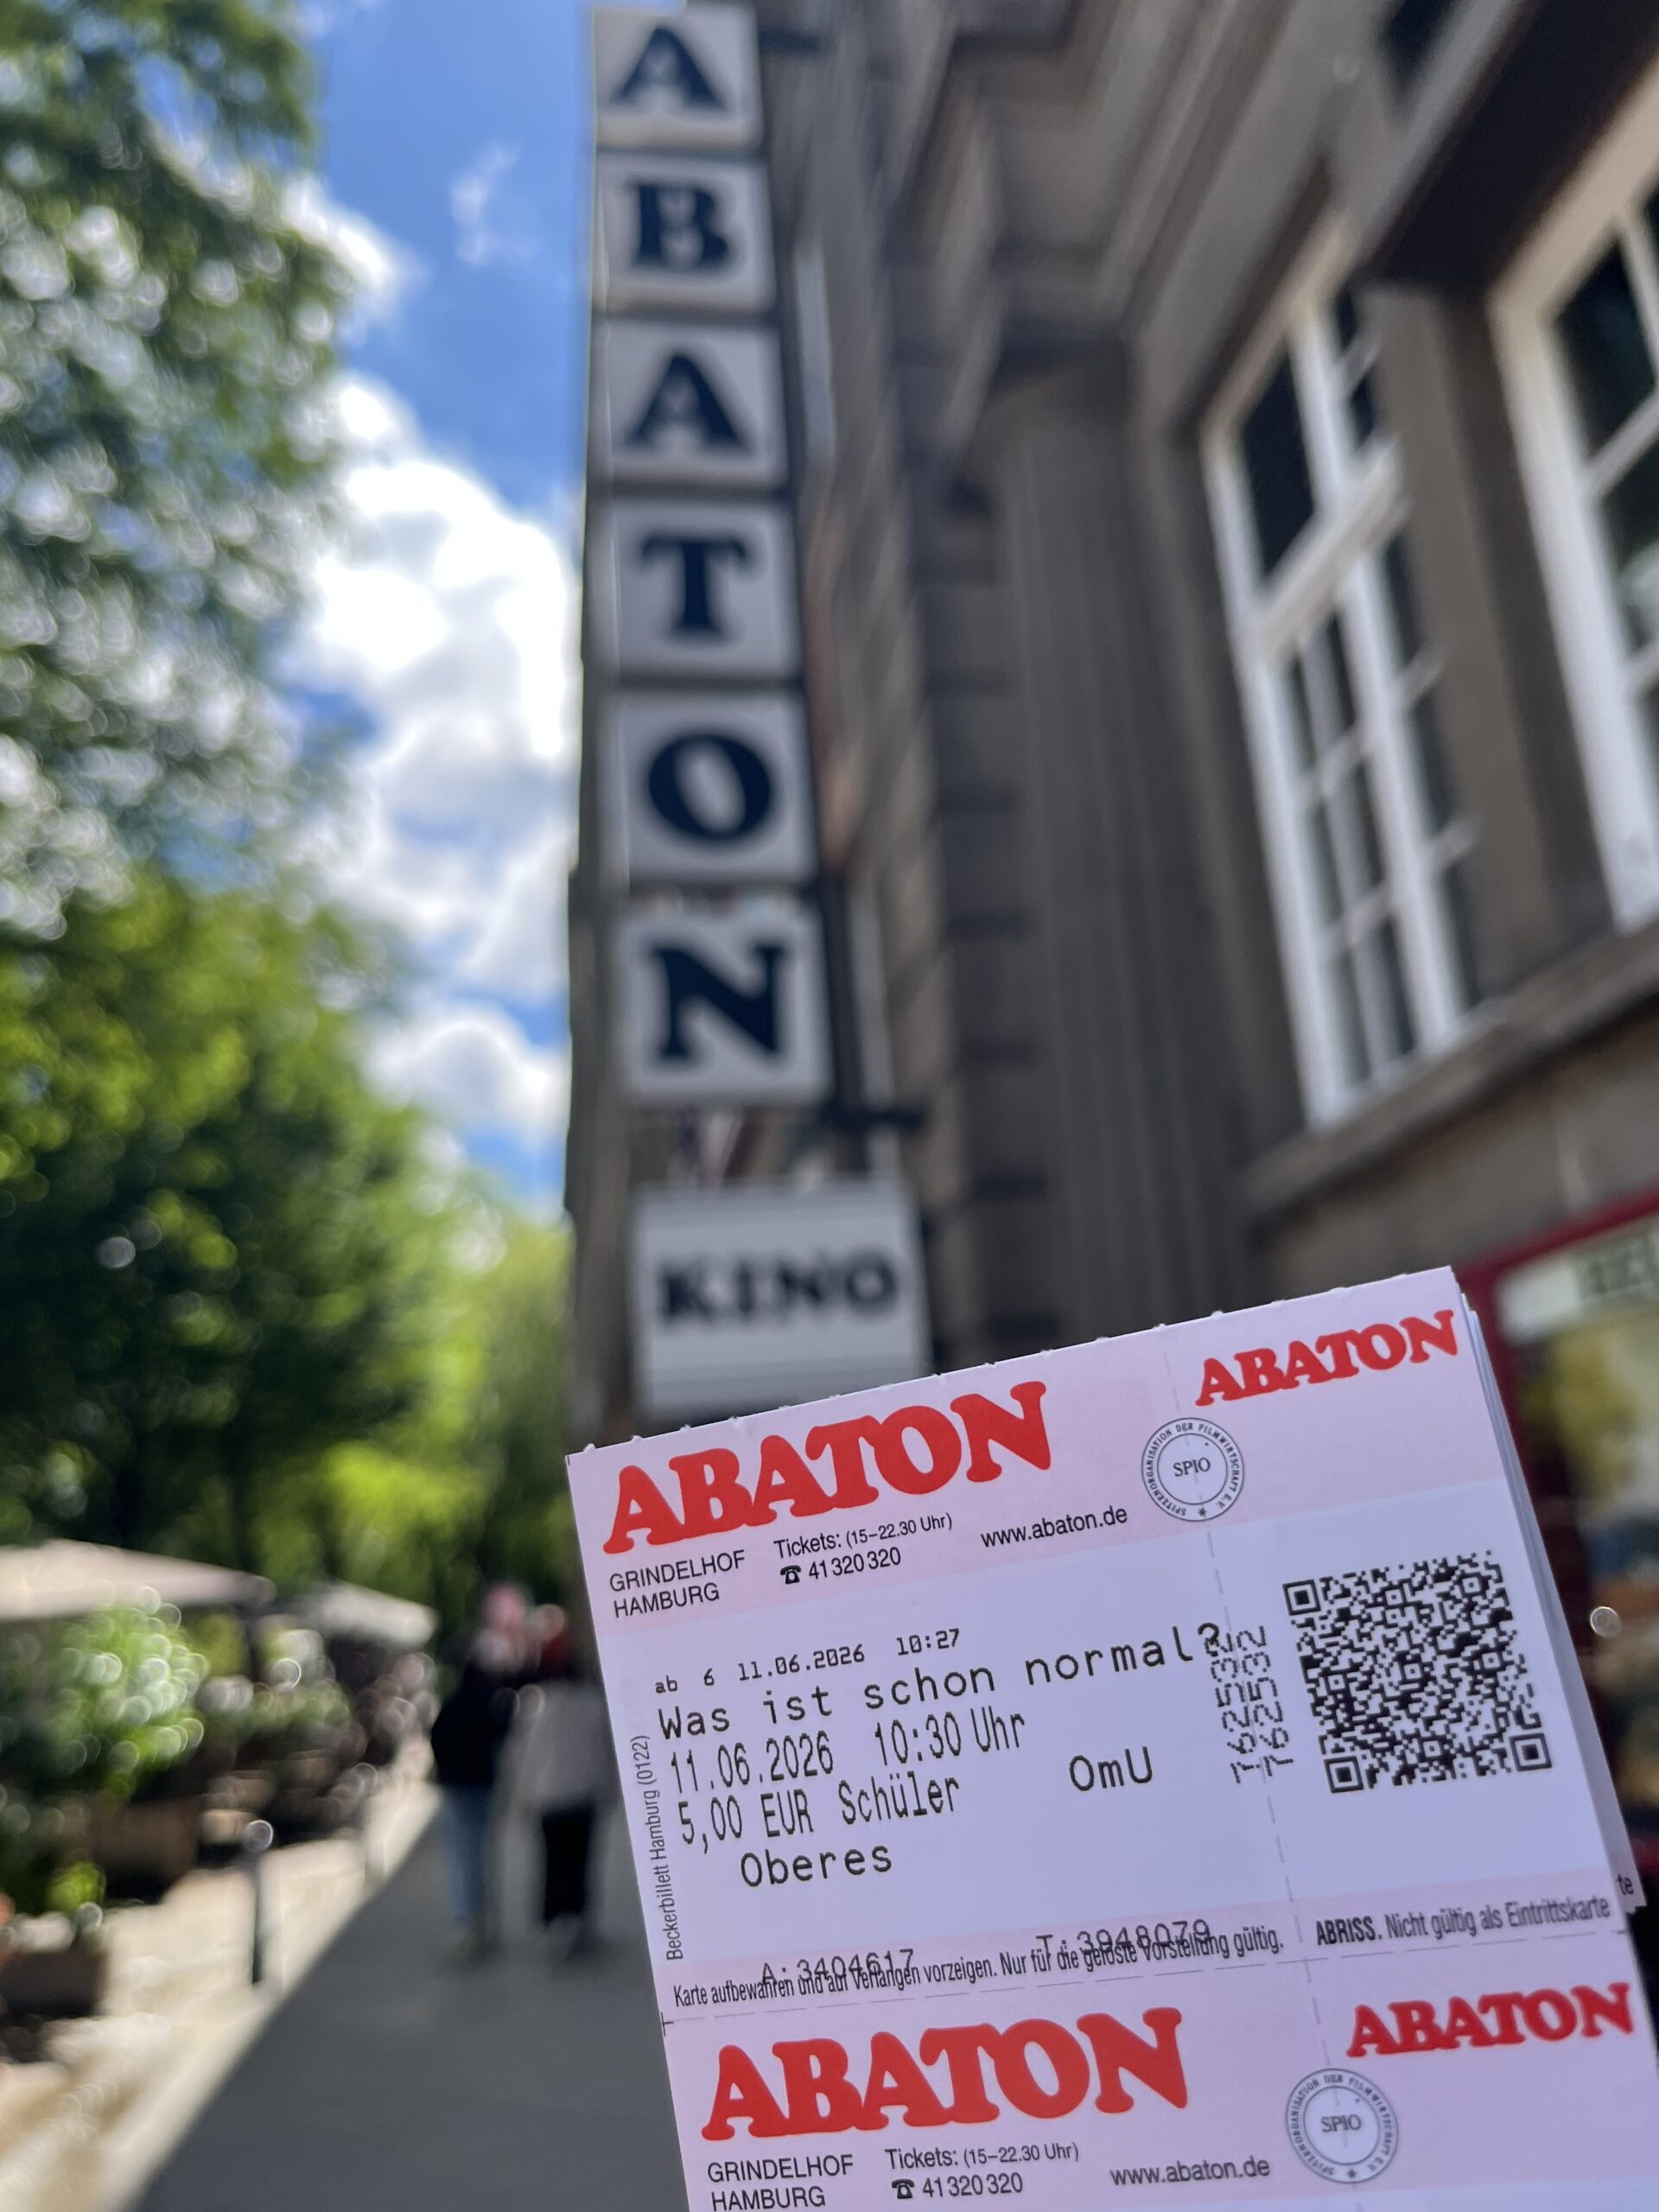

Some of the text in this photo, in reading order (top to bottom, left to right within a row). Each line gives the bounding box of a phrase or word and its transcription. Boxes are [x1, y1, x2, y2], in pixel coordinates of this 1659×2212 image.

[607, 24, 788, 1069] ABATON
[659, 1251, 900, 1325] KINO
[1196, 1310, 1458, 1406] ABATON
[603, 1382, 1052, 1554] ABATON
[1173, 1457, 1211, 1477] SPIO
[773, 1532, 842, 1560] Tickets:
[920, 1512, 953, 1532] Uhr)
[981, 1506, 1128, 1549] www.abaton.de
[609, 1550, 747, 1592] GRINDELHOF
[613, 1582, 721, 1618] HAMBURG
[655, 1629, 961, 1694] ab 6 11.06.2026 10:27
[658, 1623, 1220, 1740] Was ist schon normal?
[1236, 1624, 1294, 1777] 762532
[671, 1706, 1027, 1795] 11.06.2026 10:30 Uhr
[679, 1745, 1154, 1854] 5,00 EUR Schüler OmU
[630, 1734, 683, 1961] Beckerbillett Hamburg (0122)
[740, 1843, 893, 1889] Oberes
[1315, 1895, 1611, 1945] ABRISS. Nicht gültig als Eintrittskarte
[673, 1985, 709, 2007] Karte
[711, 1978, 796, 2004] aufbewahren
[798, 1974, 823, 1996] und
[827, 1971, 849, 1993] auf
[922, 1955, 997, 1984] vorzeigen.
[1000, 1950, 1028, 1976] Nur
[1030, 1948, 1052, 1973] für
[1056, 1944, 1080, 1971] die
[1232, 1924, 1284, 1958] gültig.
[1347, 1982, 1633, 2057] ABATON
[701, 2007, 1187, 2141] ABATON
[1320, 2113, 1363, 2133] SPIO
[707, 2154, 855, 2183] GRINDELHOF
[885, 2146, 958, 2171] Tickets:
[1044, 2142, 1080, 2162] Uhr)
[1109, 2156, 1271, 2187] www.abaton.de
[711, 2186, 827, 2212] HAMBURG
